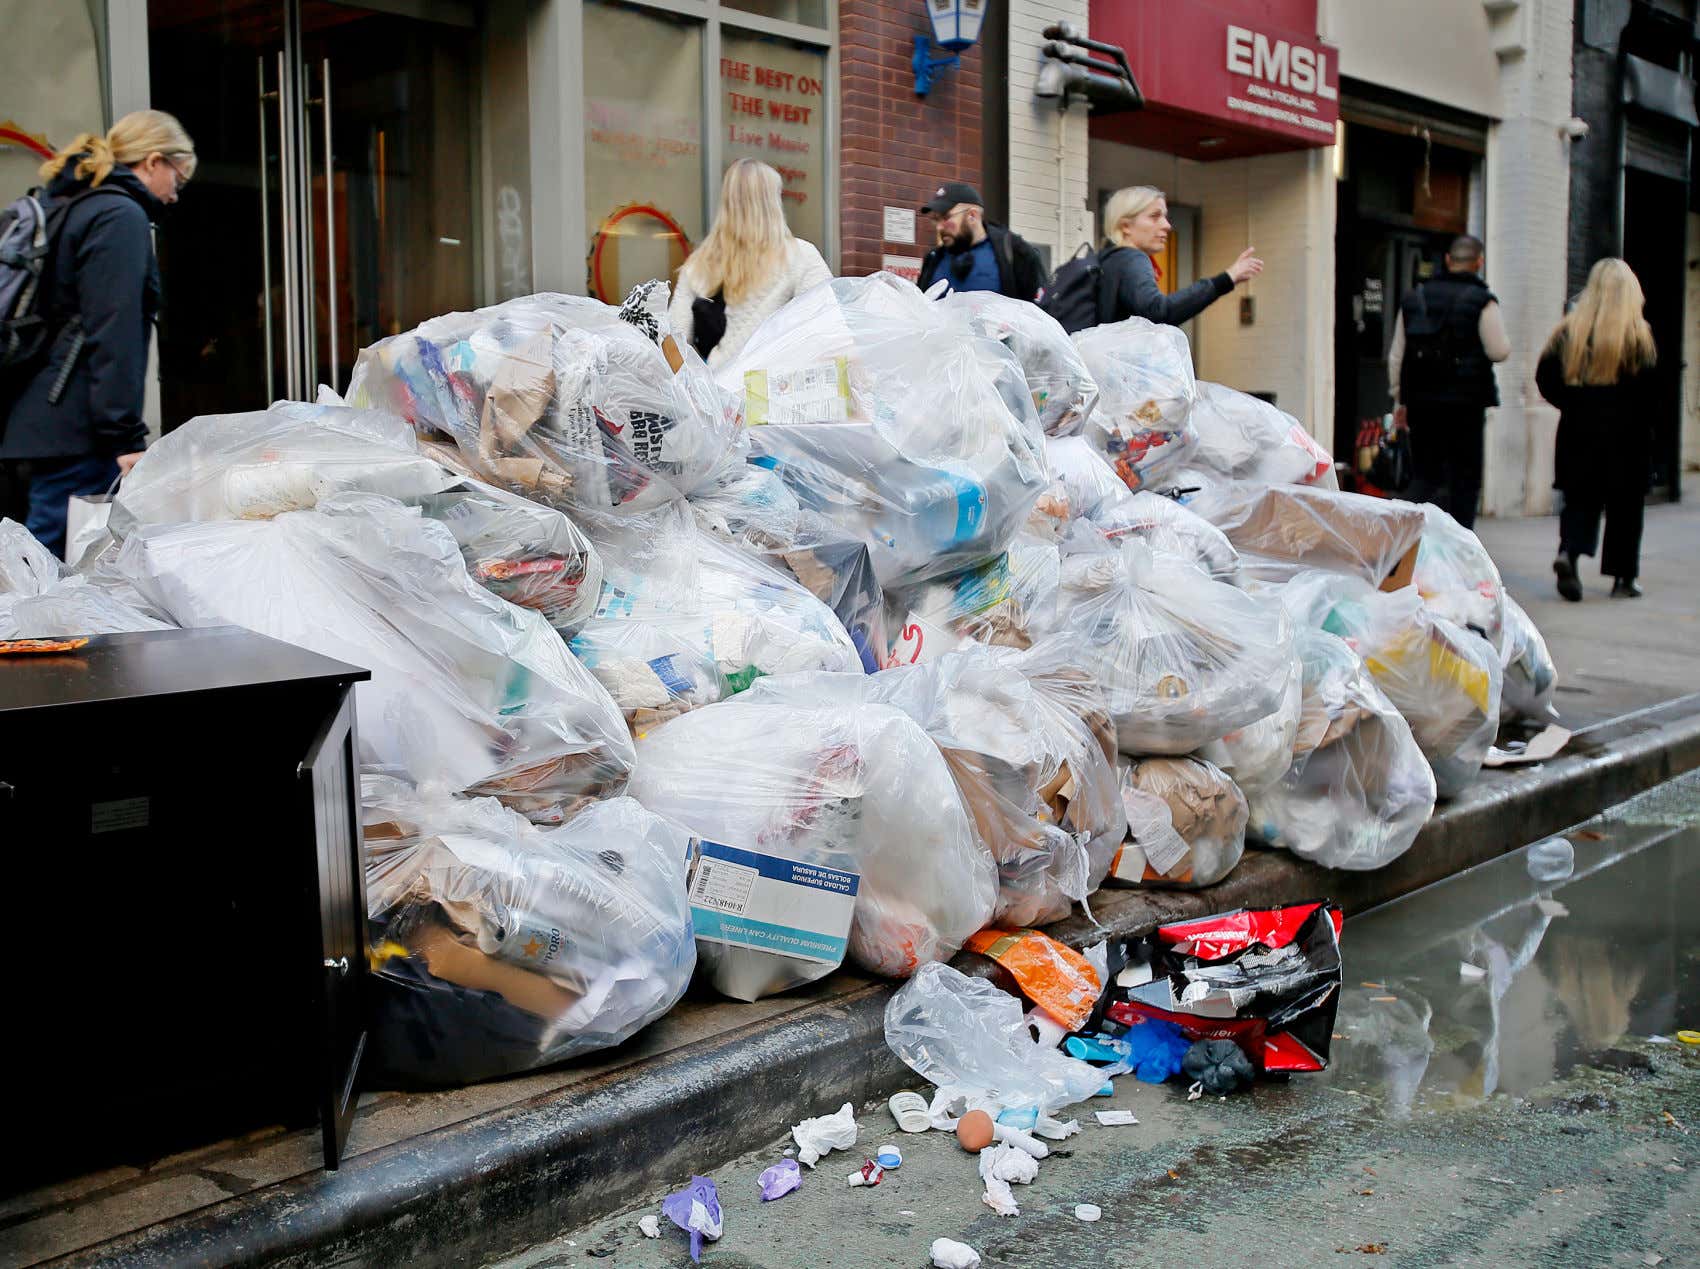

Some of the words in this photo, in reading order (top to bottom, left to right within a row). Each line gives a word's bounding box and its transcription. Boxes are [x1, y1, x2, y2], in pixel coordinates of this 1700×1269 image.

[1226, 24, 1338, 102] EMSL
[720, 58, 751, 81] THE
[754, 66, 794, 92] BEST
[797, 76, 823, 97] ON
[728, 92, 765, 118] THE
[768, 100, 812, 126] WEST
[728, 124, 764, 148] Live
[792, 865, 817, 876] BASURA
[818, 870, 828, 879] DE
[791, 874, 823, 887] SUPERIOR
[828, 872, 852, 884] BOLSAS
[823, 879, 850, 892] CALIDAD
[747, 928, 766, 939] CAN
[767, 932, 800, 945] QUALITY
[800, 938, 837, 953] PREMIUM
